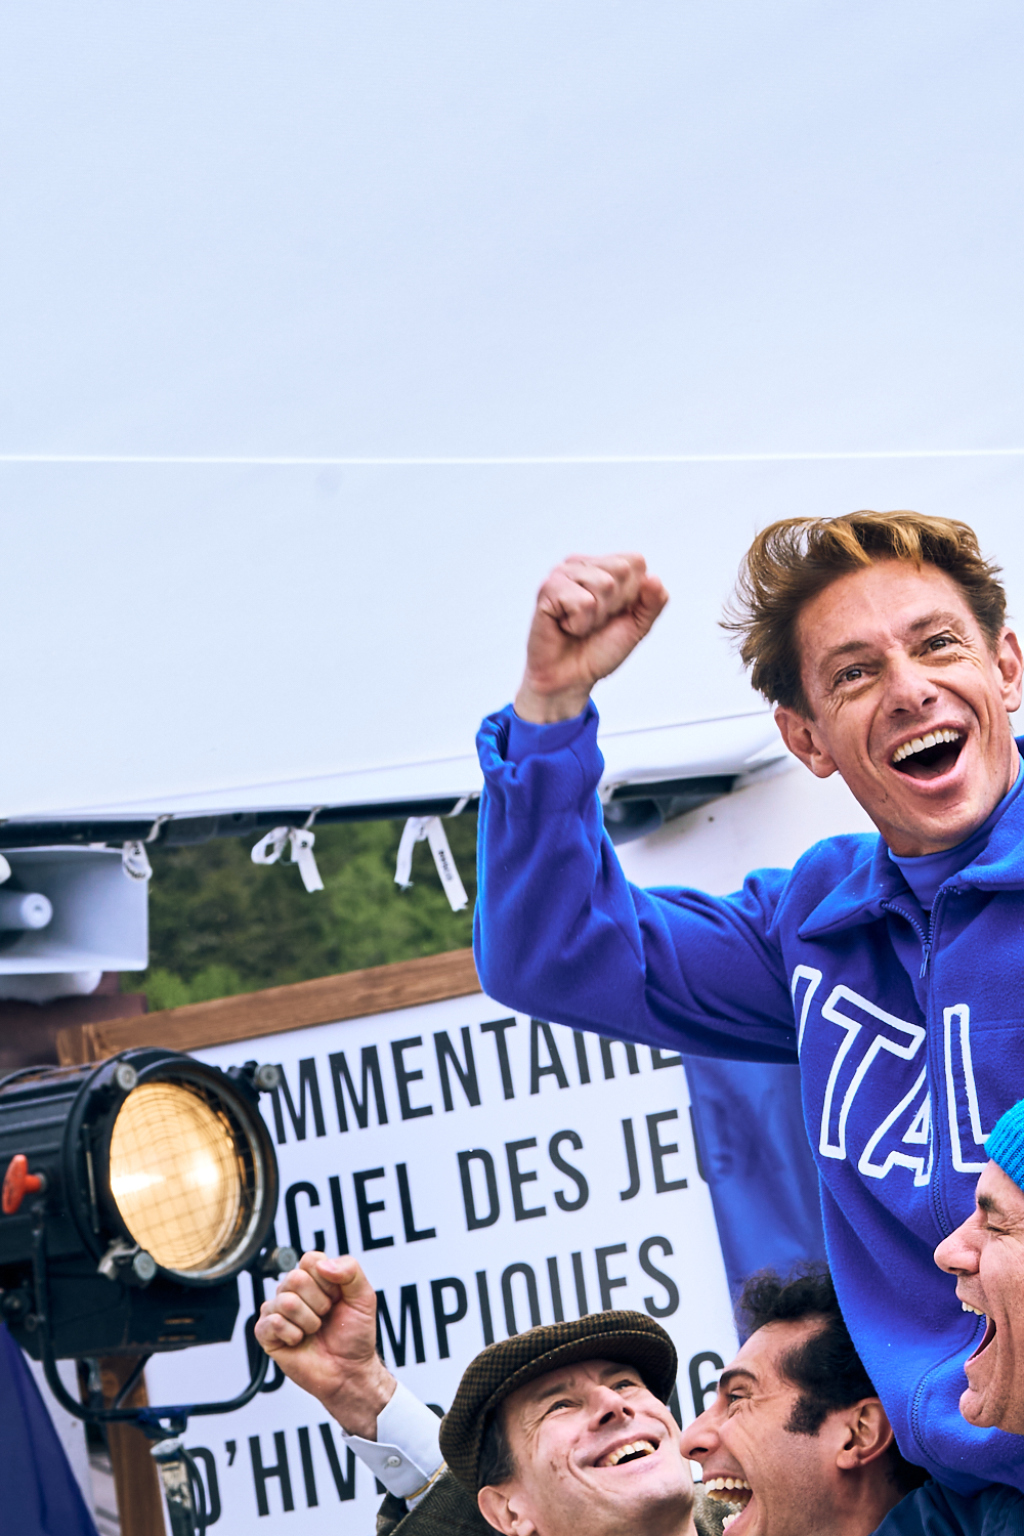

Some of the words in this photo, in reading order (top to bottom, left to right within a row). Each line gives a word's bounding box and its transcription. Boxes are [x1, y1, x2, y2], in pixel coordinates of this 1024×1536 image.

[457, 1129, 590, 1232] DES
[619, 1104, 707, 1202] JE
[185, 1422, 388, 1528] D'HIV
